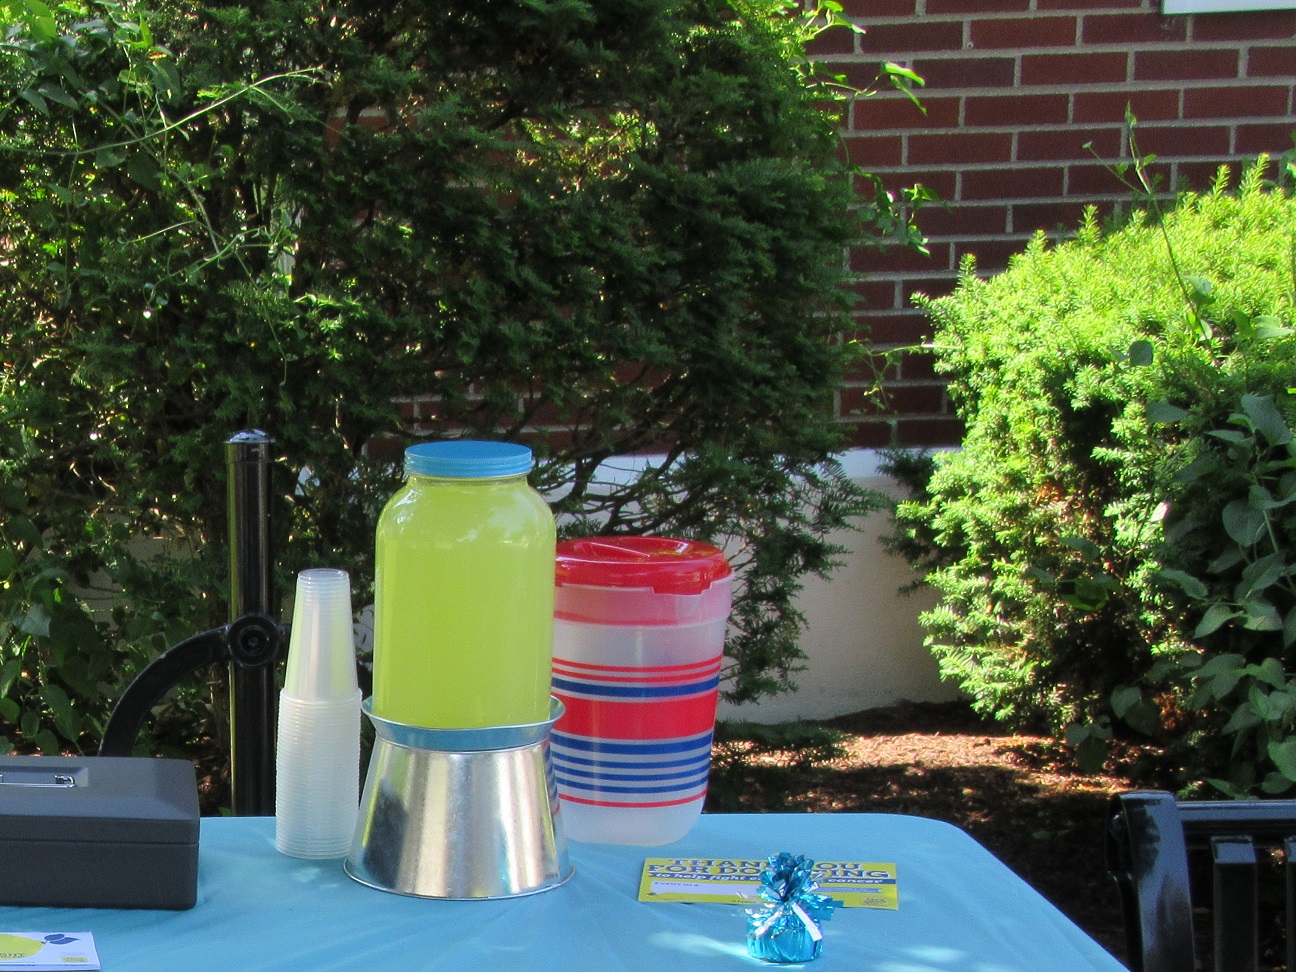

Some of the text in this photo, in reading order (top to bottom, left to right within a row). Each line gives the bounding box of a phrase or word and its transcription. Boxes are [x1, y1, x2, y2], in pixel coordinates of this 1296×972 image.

[668, 859, 861, 870] THAN OU
[648, 865, 710, 873] FOR
[673, 873, 707, 881] help
